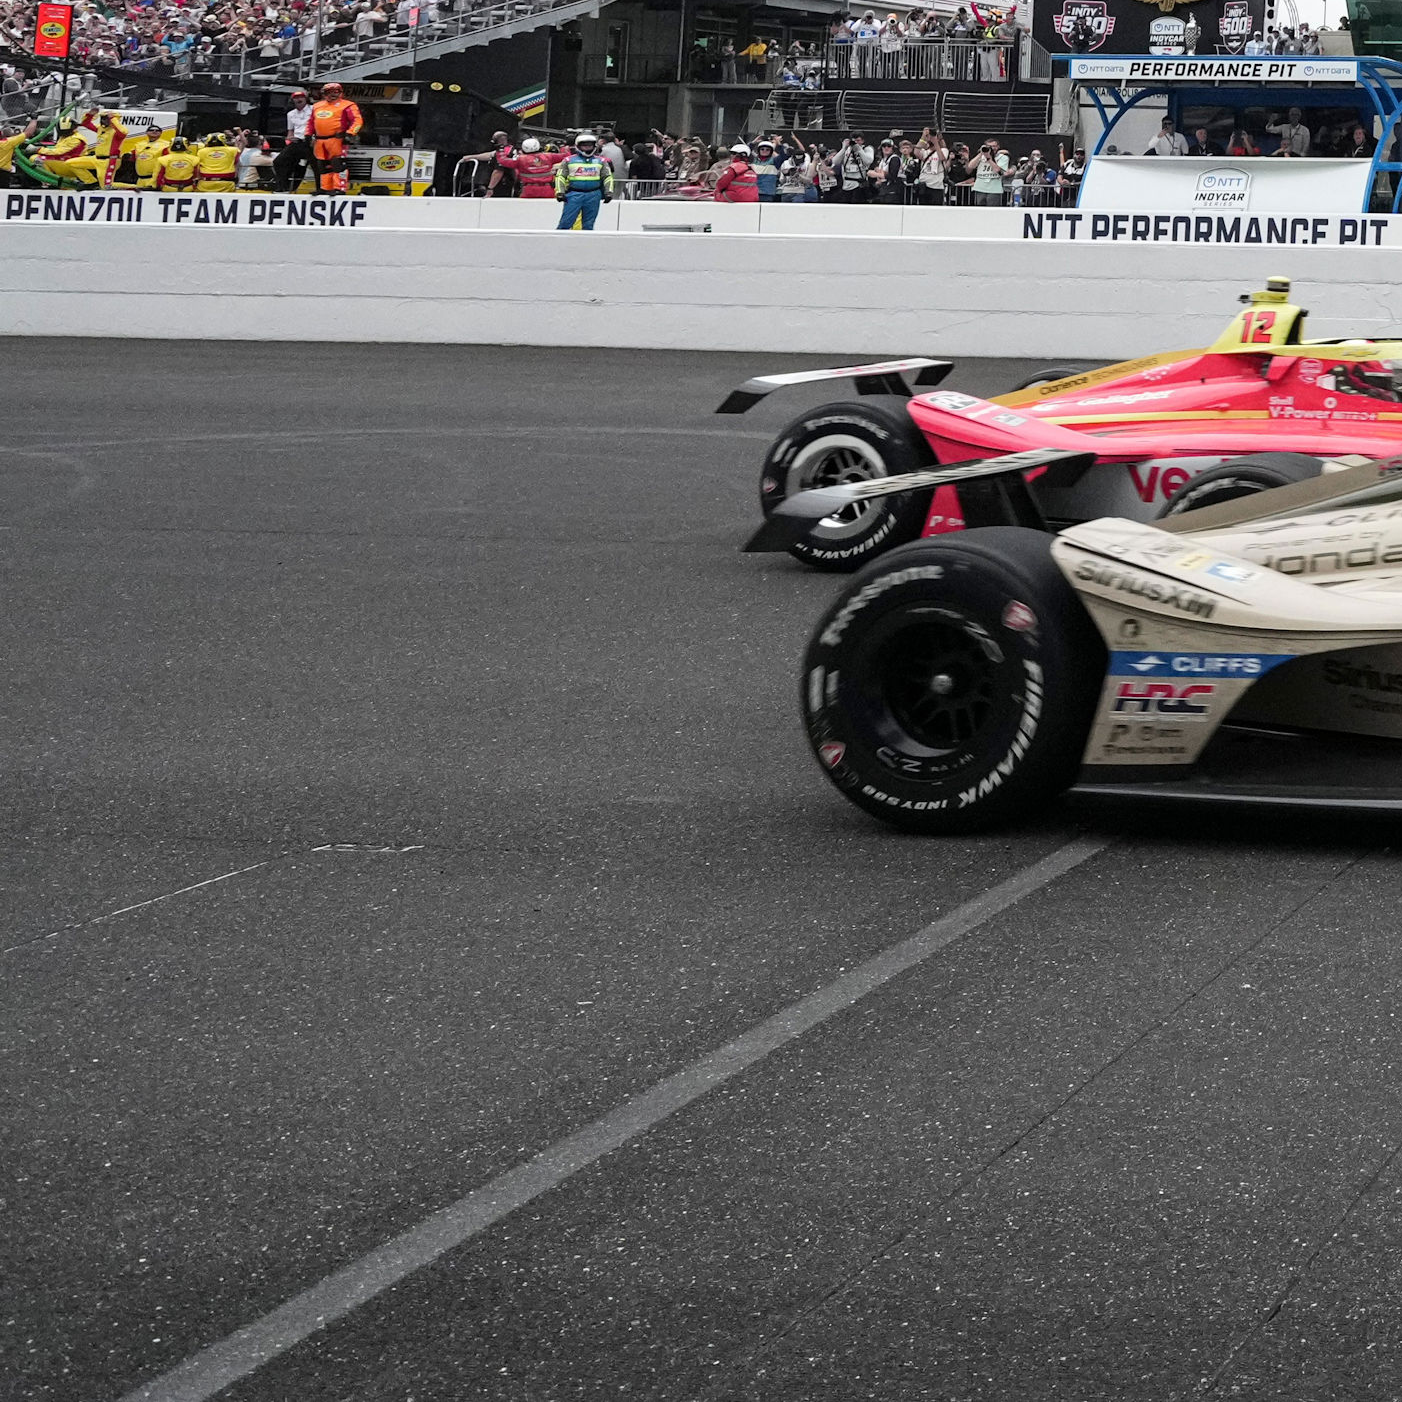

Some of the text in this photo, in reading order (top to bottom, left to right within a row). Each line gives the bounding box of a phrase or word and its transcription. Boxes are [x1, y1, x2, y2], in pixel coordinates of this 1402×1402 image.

[1071, 7, 1098, 16] INDY
[1228, 8, 1243, 17] INDY
[1223, 17, 1247, 35] 500
[1150, 35, 1184, 43] INDYCAR
[1089, 65, 1105, 73] NTT
[1129, 63, 1298, 78] PERFORMANCE PIT
[1315, 67, 1331, 75] NTT
[1217, 178, 1243, 188] NTT
[1195, 192, 1245, 202] INDYCAR
[6, 194, 367, 227] PENNZOIL TEAM PENSKE
[1024, 213, 1388, 246] NTT PERFORMANCE PIT
[1240, 311, 1276, 344] 12
[1039, 376, 1089, 396] Clarience
[1269, 397, 1294, 405] Shell
[1269, 406, 1331, 420] V-Power
[811, 513, 898, 559] FIREHAWK
[1073, 560, 1218, 619] SiriusXM
[1171, 655, 1263, 675] CLIFFS
[1113, 682, 1217, 716] HRC
[958, 658, 1045, 809] FIREHAWK
[861, 784, 949, 811] INDY 500
